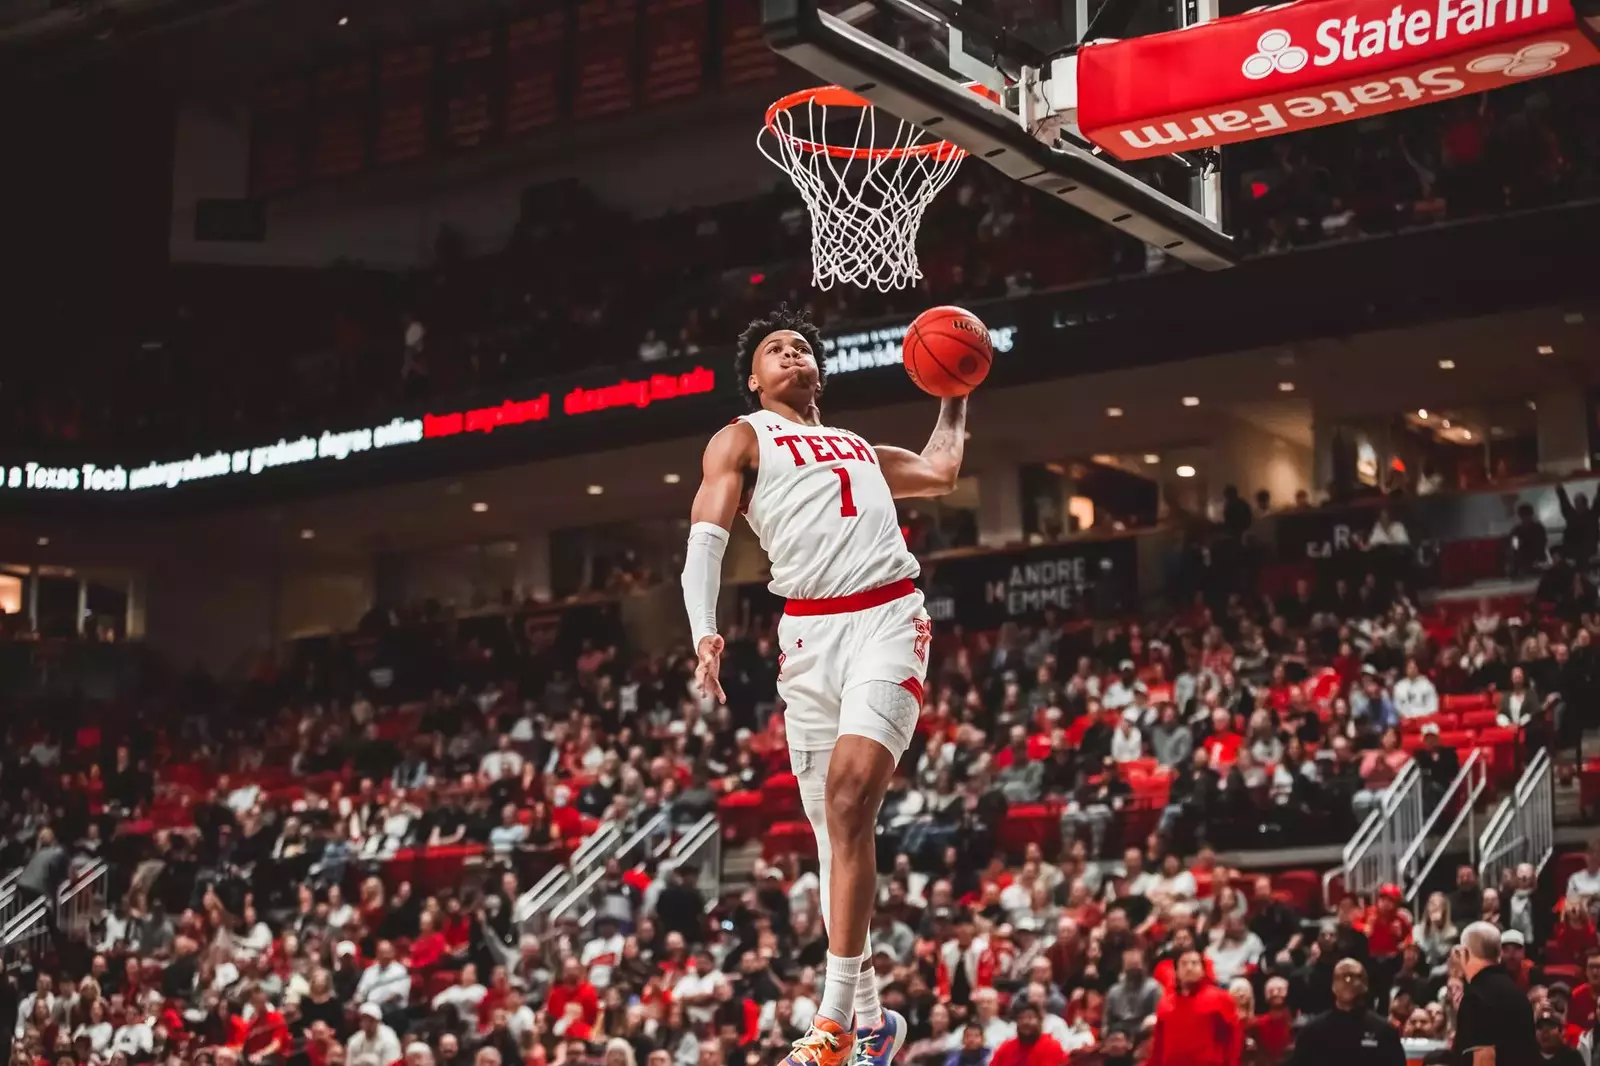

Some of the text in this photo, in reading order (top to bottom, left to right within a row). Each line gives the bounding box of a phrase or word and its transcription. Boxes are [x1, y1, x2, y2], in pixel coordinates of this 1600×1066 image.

[773, 435, 876, 467] TECH
[831, 467, 858, 517] 1
[1009, 558, 1085, 587] ANDRE
